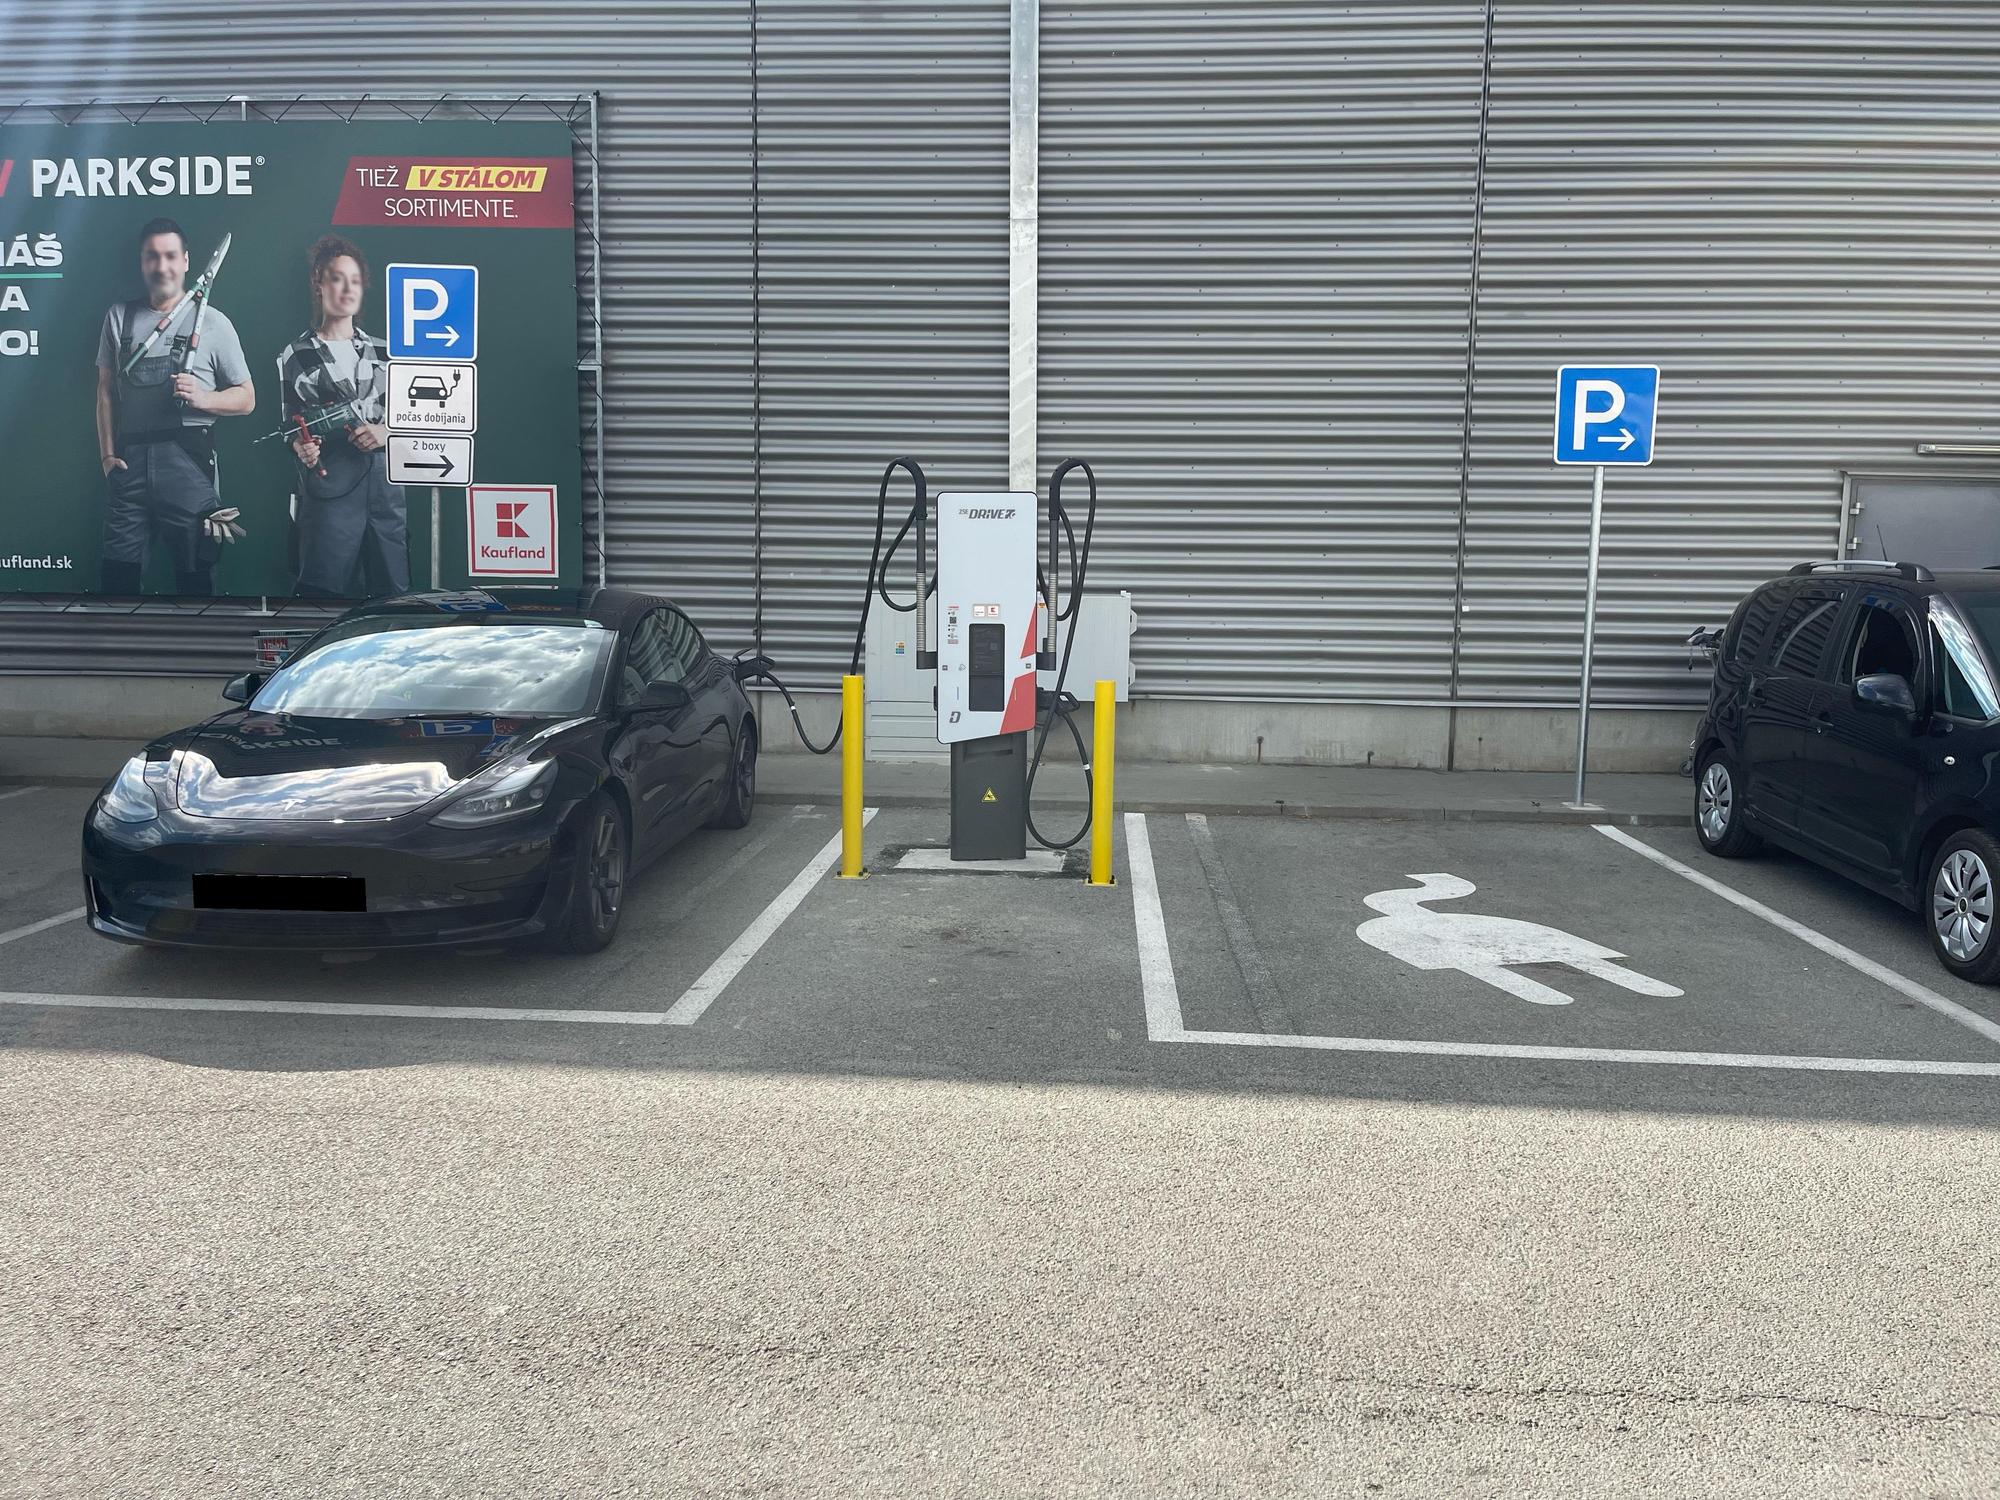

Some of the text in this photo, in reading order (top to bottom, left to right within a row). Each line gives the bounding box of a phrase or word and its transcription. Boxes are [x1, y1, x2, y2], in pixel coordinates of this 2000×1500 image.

[356, 165, 537, 189] TIEŽ V STÁLOM
[384, 198, 519, 219] SORTIMENTE.
[0, 232, 63, 267] ÁŠ
[403, 278, 449, 347] P
[396, 411, 422, 424] počas
[1572, 380, 1626, 451] P
[412, 440, 446, 453] 2 boxy
[0, 555, 73, 569] ufland.sk
[481, 545, 545, 559] Kaufland
